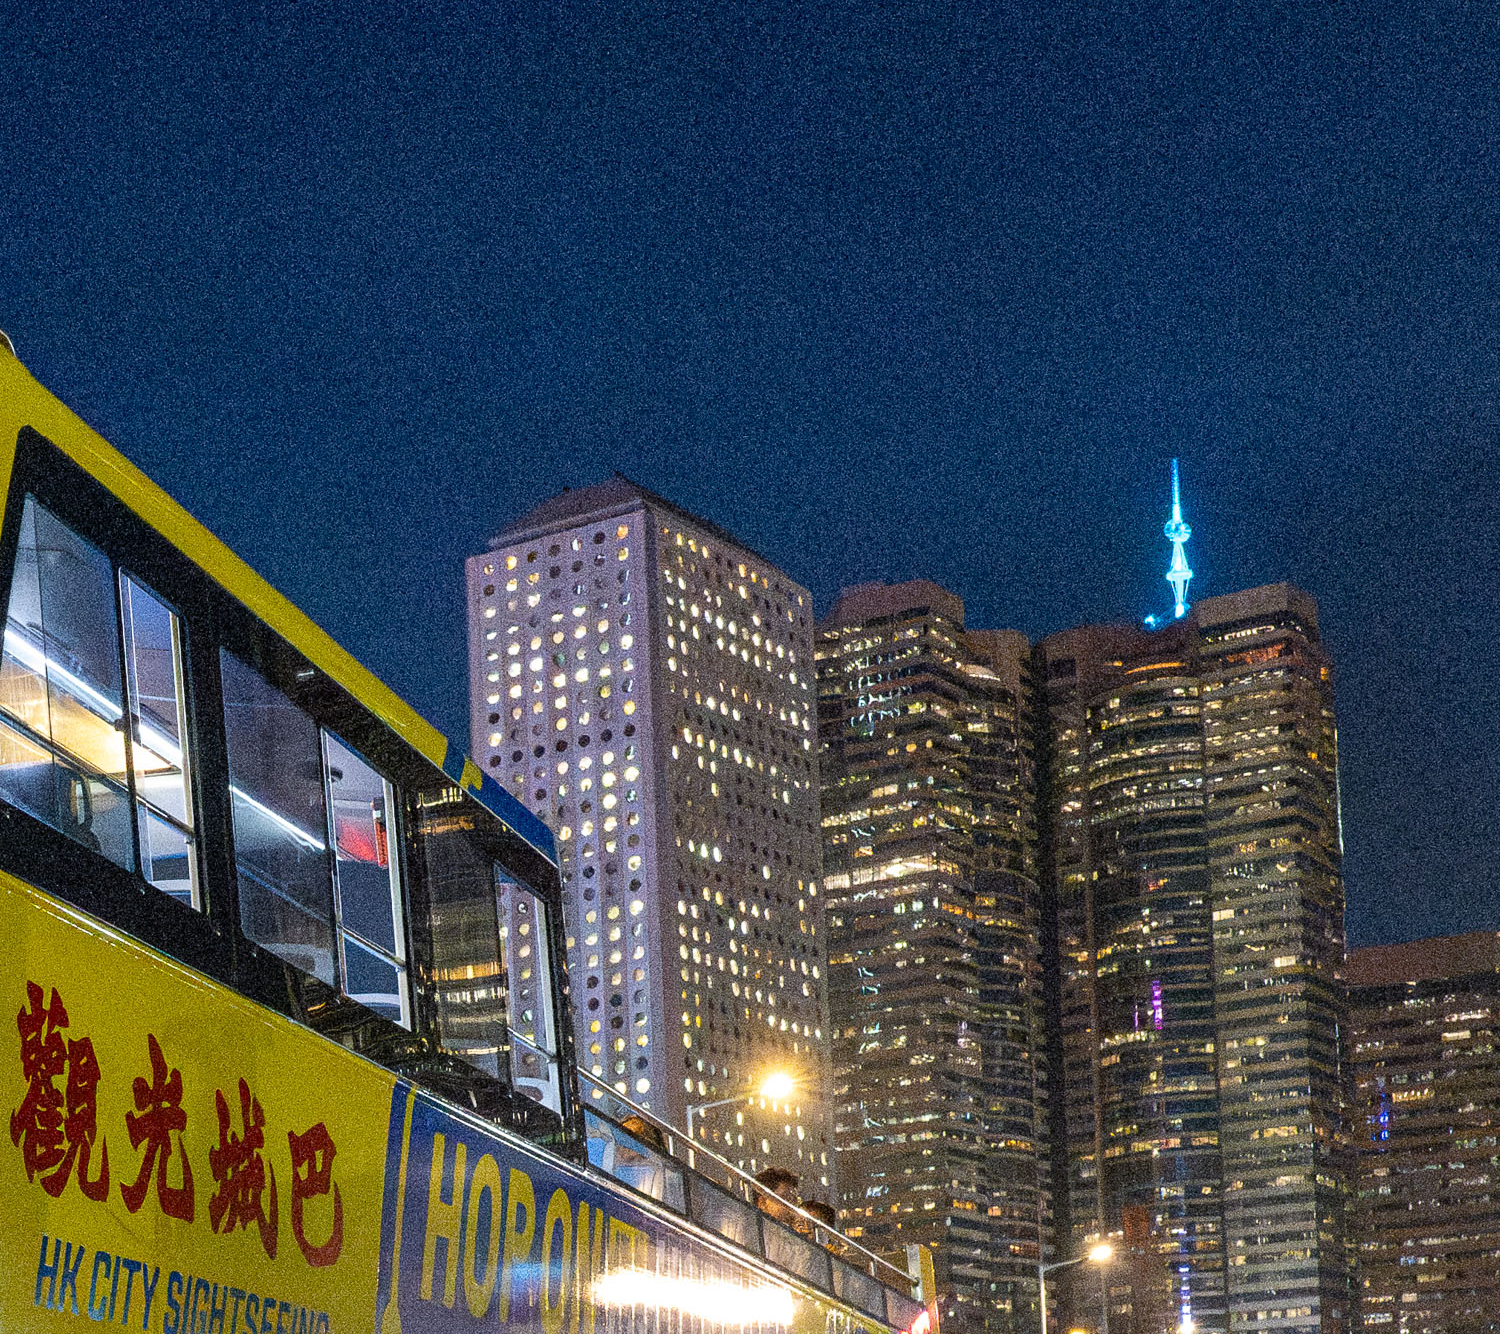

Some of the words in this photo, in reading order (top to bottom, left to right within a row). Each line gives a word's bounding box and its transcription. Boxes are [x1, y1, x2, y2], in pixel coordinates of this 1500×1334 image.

[10, 979, 344, 1268] 觀光城巴
[34, 1235, 86, 1316] HK
[87, 1250, 160, 1331] CITY
[420, 1133, 536, 1323] HOP
